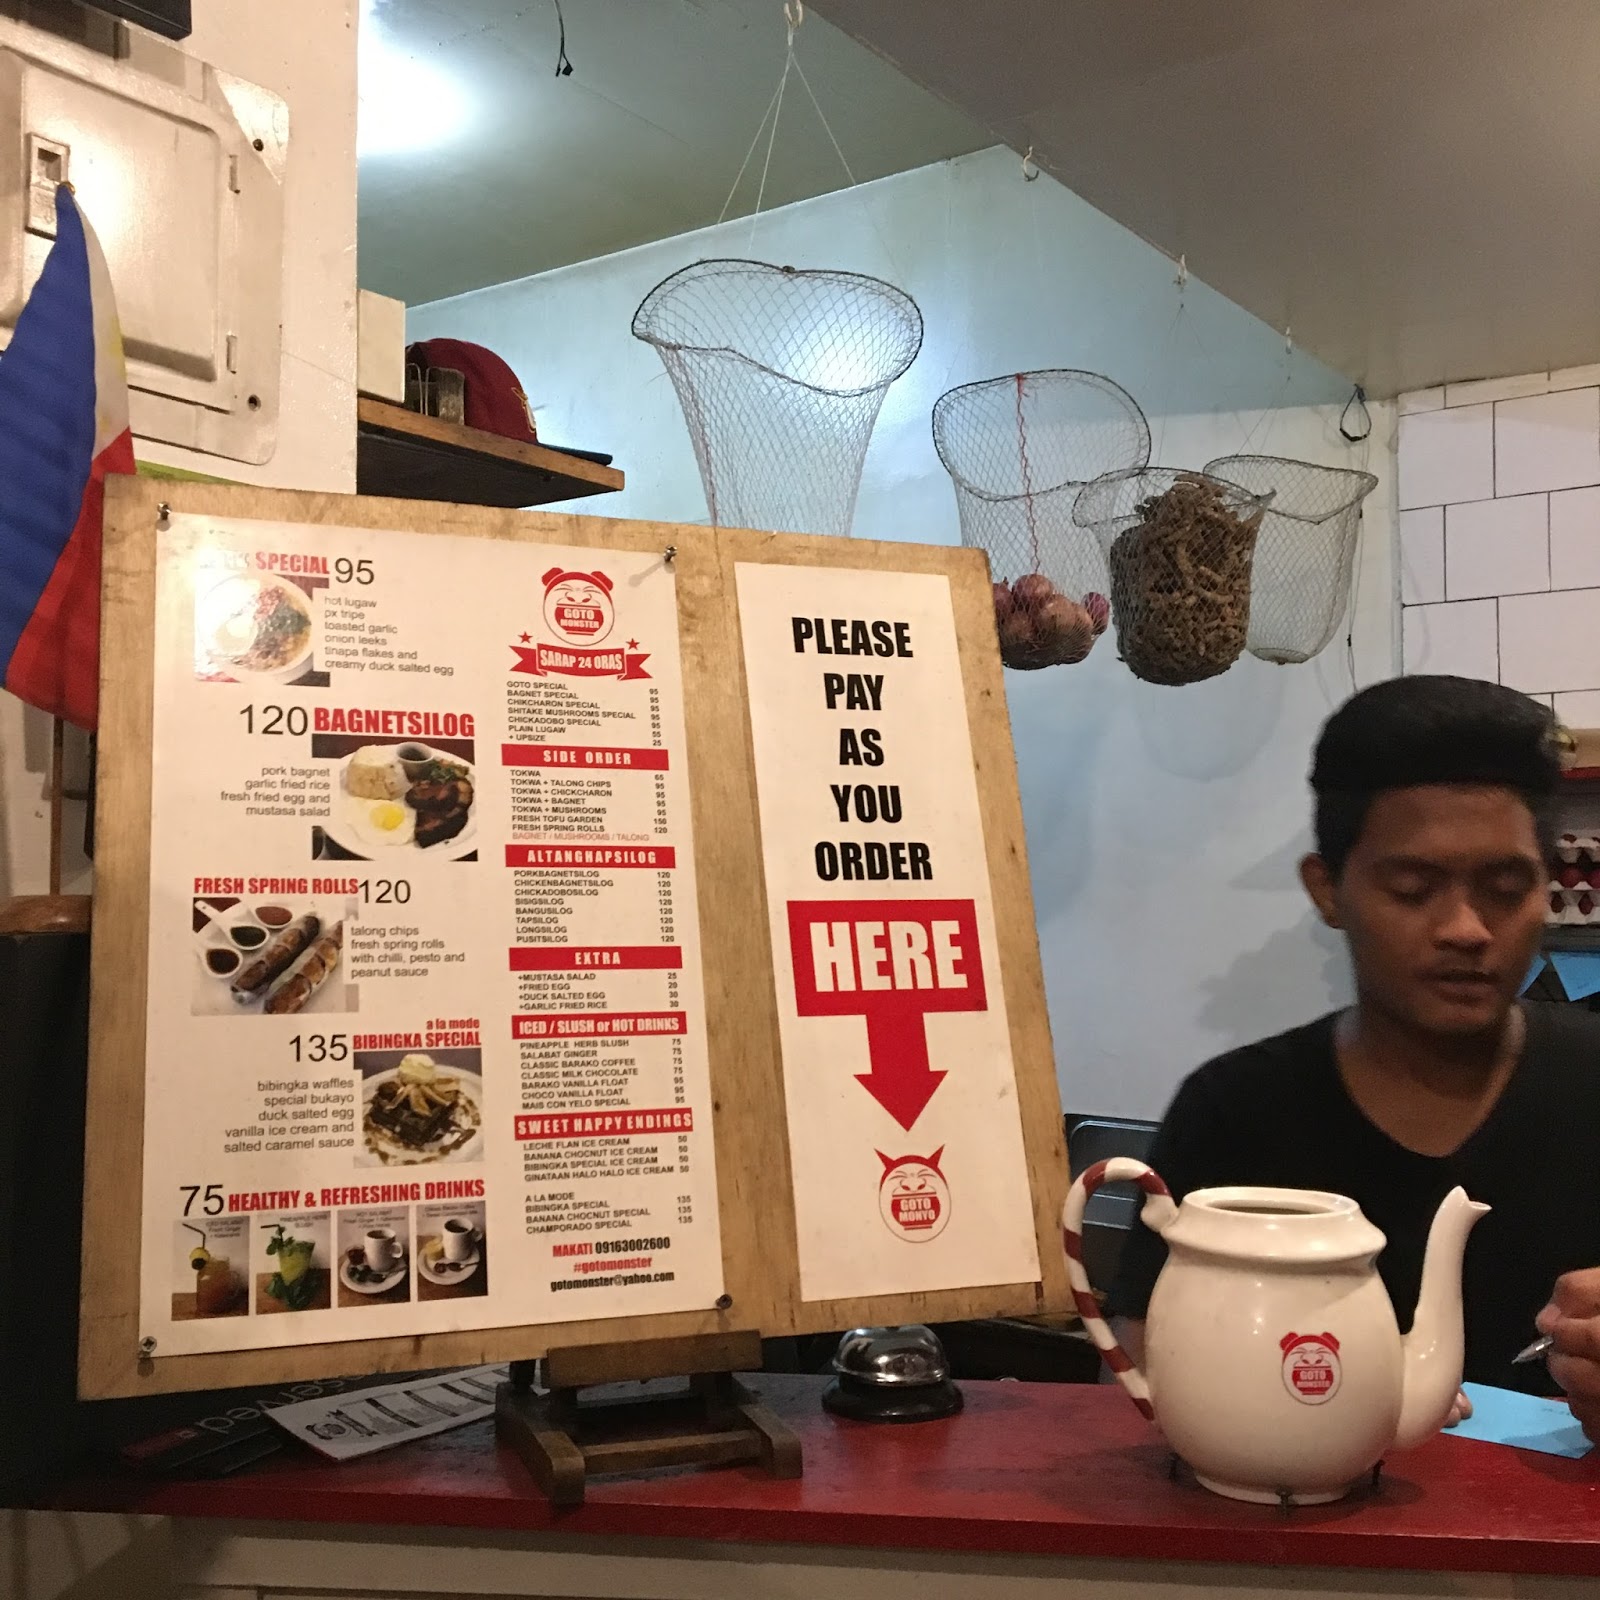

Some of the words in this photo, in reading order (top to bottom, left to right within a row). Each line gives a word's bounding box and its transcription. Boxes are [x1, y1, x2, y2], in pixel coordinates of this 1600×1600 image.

[255, 552, 330, 575] SPECIAL
[335, 557, 375, 585] 95
[324, 609, 338, 619] px
[340, 609, 366, 621] tripe
[563, 608, 595, 620] GOTO
[324, 621, 366, 632] toasted
[368, 624, 398, 635] garlic
[791, 616, 914, 658] PLEASE
[540, 649, 576, 668] SARAP
[578, 658, 592, 669] 24
[594, 653, 623, 670] ORAS
[324, 660, 366, 672] creamy
[368, 661, 395, 671] duck
[398, 663, 431, 673] salted
[433, 666, 454, 677] egg
[506, 680, 531, 689] GOTO
[532, 681, 568, 691] SPECIAL
[823, 672, 884, 711] PAY
[507, 689, 542, 698] BAGNET
[543, 691, 579, 700] SPECIAL
[507, 707, 543, 715] SHITAKE
[545, 708, 600, 718] MUSHROOMS
[601, 711, 636, 719] SPECIAL
[240, 704, 308, 737] 120
[314, 707, 475, 737] BAGNETSILOG
[508, 724, 534, 732] PLAIN
[535, 726, 566, 734] LUGAW
[838, 728, 885, 767] AS
[543, 749, 577, 763] SIDE
[585, 751, 631, 765] ORDER
[261, 766, 287, 777] pork
[290, 766, 330, 779] bagnet
[510, 769, 541, 777] TOKWA
[244, 779, 277, 791] garlic
[280, 778, 307, 790] fried
[309, 780, 331, 791] rice
[510, 778, 542, 786] TOKWA
[550, 779, 585, 787] TALONG
[586, 780, 612, 788] CHIPS
[220, 790, 251, 802] fresh
[253, 791, 280, 803] fried
[282, 794, 306, 806] egg
[308, 794, 331, 804] and
[829, 784, 903, 824] YOU
[511, 814, 541, 822] FRESH
[542, 815, 565, 823] TOFU
[567, 815, 603, 824] GARDEN
[512, 823, 541, 831] FRESH
[542, 824, 575, 832] SPRING
[576, 824, 605, 833] ROLLS
[527, 850, 656, 864] ALTANGHAPSILOG
[814, 841, 933, 881] ORDER
[513, 870, 600, 878] PORKBAGNETSILOG
[194, 877, 244, 894] FRESH
[248, 877, 308, 894] SPRING
[312, 878, 359, 895] ROLLS
[514, 879, 614, 887] CHICKENBAGNETSILOG
[358, 879, 411, 904] 120
[514, 888, 599, 896] CHICKADOBOSILOG
[350, 925, 386, 938] talong
[388, 926, 420, 938] chips
[350, 939, 380, 950] fresh
[383, 939, 419, 952] spring
[421, 938, 445, 949] rolls
[516, 935, 568, 943] PUSITSILOG
[350, 953, 375, 963] with
[377, 952, 406, 964] chilli,
[409, 952, 441, 965] pesto
[443, 952, 465, 963] and
[575, 951, 621, 965] EXTRA
[808, 919, 969, 993] HERE
[517, 973, 565, 982] +MUSTASA
[566, 972, 596, 981] SALAD
[518, 983, 550, 991] +FRIED
[551, 982, 571, 991] EGG
[426, 1020, 434, 1030] a
[435, 1018, 447, 1030] la
[448, 1017, 480, 1030] mode
[519, 1020, 547, 1035] ICED
[557, 1019, 595, 1034] SLUSH
[596, 1021, 610, 1033] or
[611, 1018, 635, 1032] HOT
[636, 1017, 679, 1032] DRINKS
[353, 1033, 423, 1050] BIBINGKA
[425, 1031, 482, 1048] SPECIAL
[519, 1041, 569, 1050] PINEAPPLE
[574, 1040, 599, 1048] HERB
[600, 1039, 629, 1048] SLUSH
[289, 1034, 348, 1063] 135
[520, 1051, 561, 1060] SALABAT
[563, 1049, 598, 1059] GINGER
[520, 1060, 559, 1070] CLASSIC
[561, 1059, 600, 1069] BARAKO
[601, 1058, 635, 1067] COFFEE
[257, 1079, 309, 1094] bibingka
[312, 1077, 354, 1090] waffles
[263, 1094, 308, 1109] special
[310, 1093, 355, 1106] bukayo
[521, 1091, 555, 1100] CHOCO
[556, 1089, 594, 1098] VANILLA
[595, 1088, 623, 1097] FLOAT
[224, 1125, 265, 1138] vanilla
[268, 1124, 287, 1136] ice
[289, 1124, 328, 1135] cream
[331, 1121, 355, 1133] and
[517, 1118, 569, 1135] SWEET
[573, 1116, 622, 1132] HAPPY
[626, 1112, 692, 1130] ENDINGS
[523, 1151, 563, 1161] BANANA
[564, 1148, 608, 1159] CHOCNUT
[610, 1148, 624, 1156] ICE
[626, 1146, 658, 1155] CREAM
[179, 1184, 225, 1217] 75
[228, 1190, 301, 1213] HEALTHY
[304, 1191, 317, 1208] &
[320, 1183, 421, 1207] REFRESHING
[424, 1179, 485, 1200] DRINKS
[900, 1197, 931, 1211] GOTO
[526, 1222, 593, 1235] CHAMPORADO
[594, 1219, 632, 1230] SPECIAL
[552, 1242, 593, 1257] MAKATI
[595, 1237, 671, 1254] 09163002600
[573, 1257, 653, 1274] #gotomonster
[550, 1271, 675, 1292] gotomonster@yahoo.com
